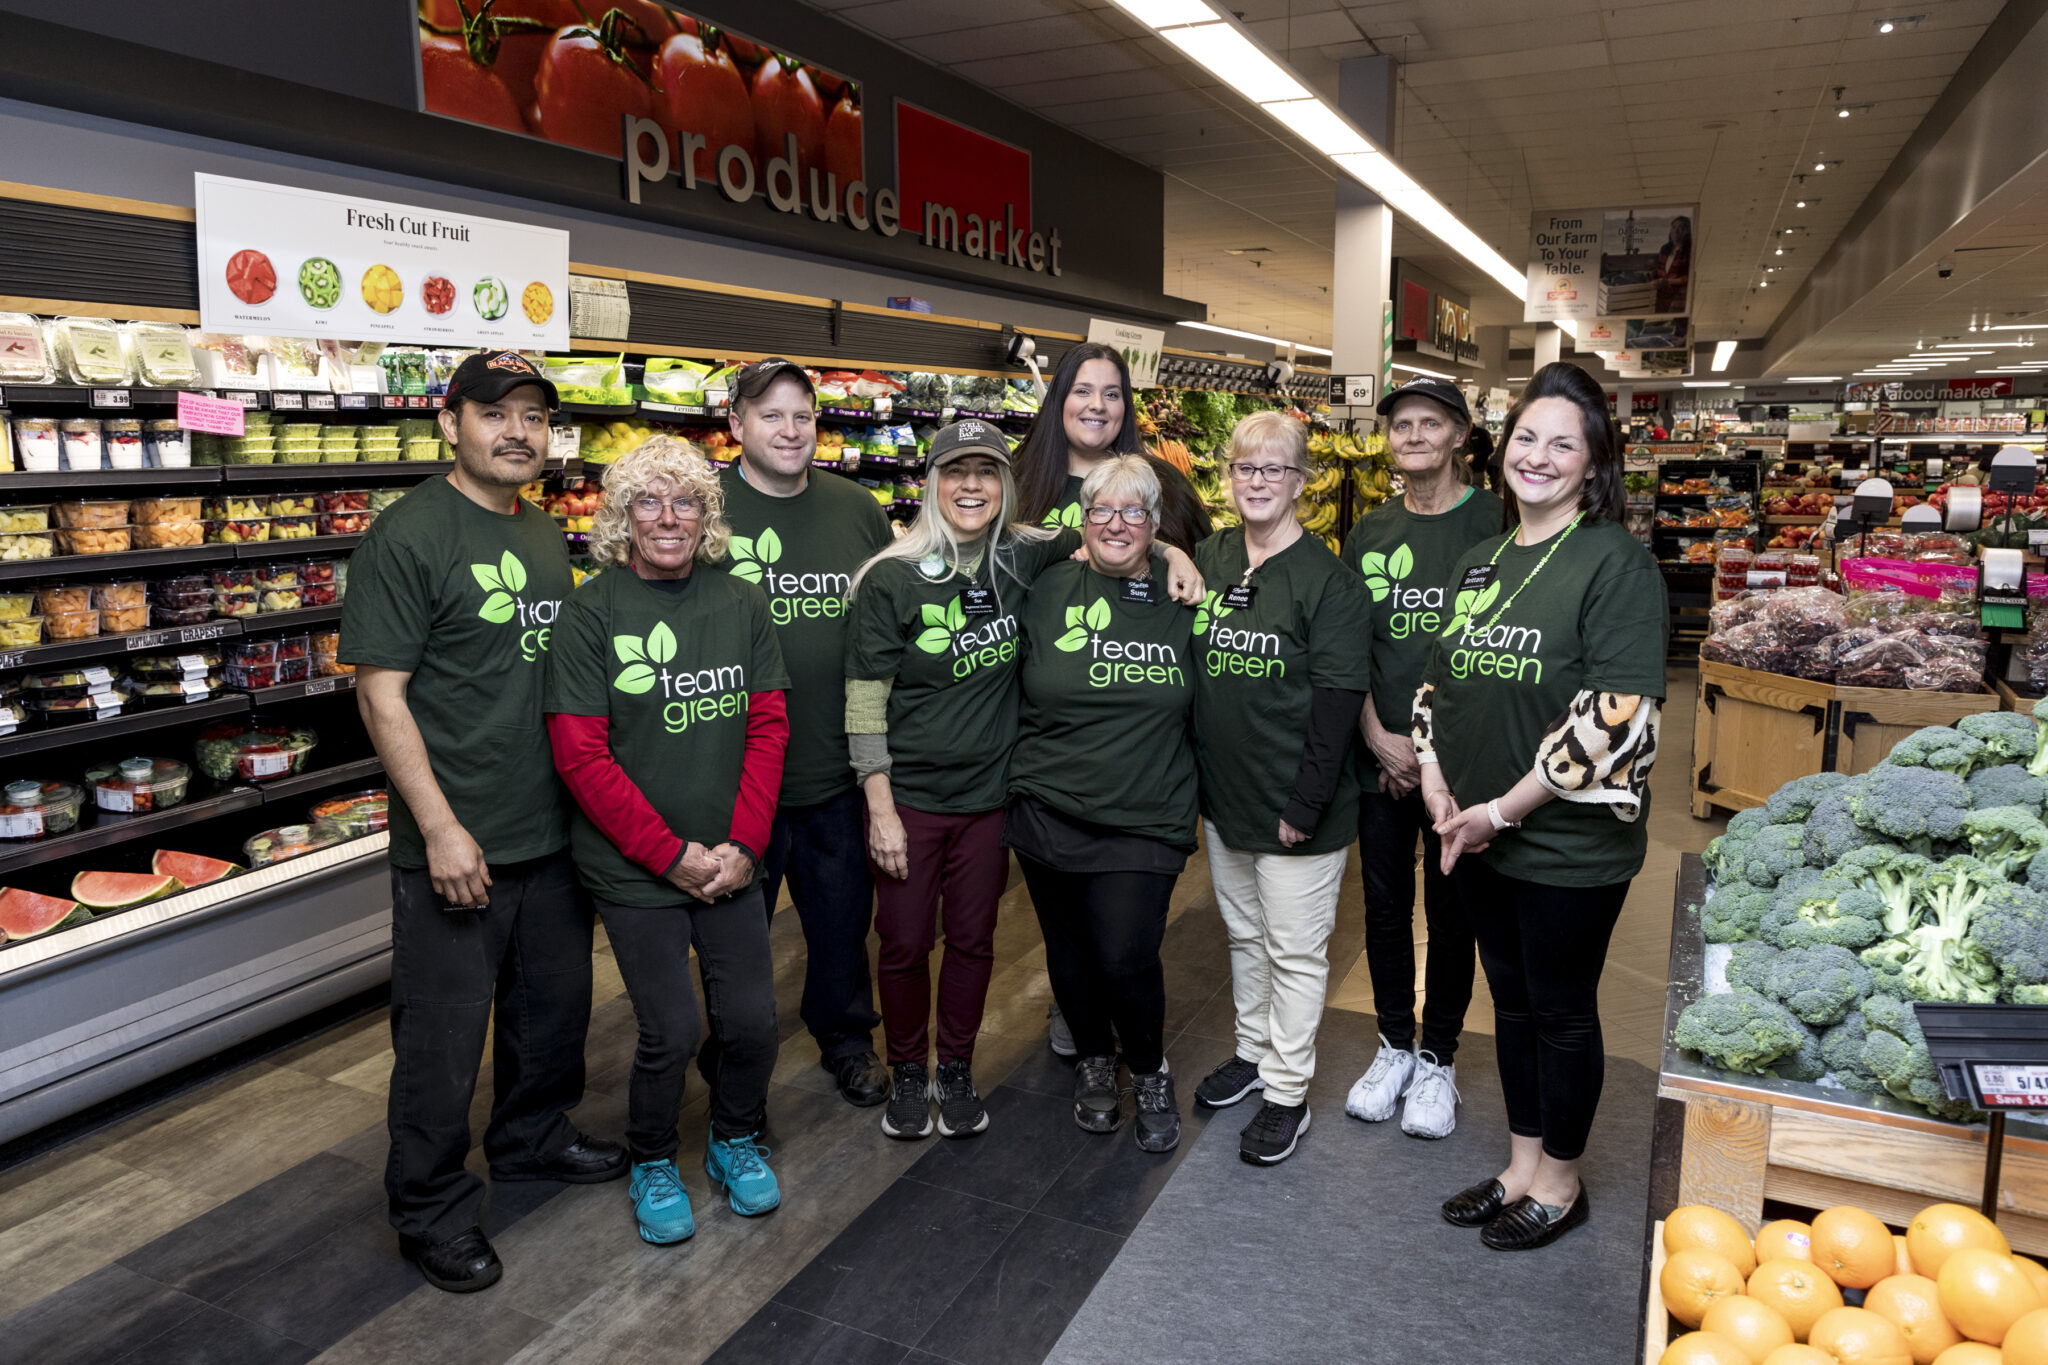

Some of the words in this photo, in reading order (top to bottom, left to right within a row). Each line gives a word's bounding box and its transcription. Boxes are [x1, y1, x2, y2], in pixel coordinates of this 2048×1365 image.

[623, 113, 900, 237] produce
[924, 201, 1062, 277] market
[346, 208, 394, 232] Fresh
[400, 216, 427, 236] Cut
[432, 221, 470, 242] Fruit
[1550, 217, 1583, 230] From
[1536, 233, 1561, 246] Our
[1564, 232, 1597, 244] Farm
[1540, 248, 1555, 260] To
[1559, 248, 1589, 260] Your
[1545, 262, 1584, 275] Table.
[113, 395, 129, 404] 3.99
[1872, 384, 1934, 400] safood
[1938, 382, 1998, 399] market
[674, 405, 700, 413] Certified
[765, 567, 851, 594] team
[1130, 589, 1147, 598] Susy
[1228, 594, 1248, 602] Renee
[1392, 583, 1444, 608] tea
[183, 625, 216, 641] GRAPES
[1209, 619, 1280, 656] team
[1389, 612, 1441, 639] gre
[1459, 618, 1542, 654] team
[1090, 633, 1177, 664] team
[1089, 661, 1185, 688] green
[1206, 650, 1286, 679] green
[1450, 649, 1543, 685] green
[659, 663, 744, 699] team
[663, 689, 749, 734] green
[1995, 1094, 2023, 1104] Save
